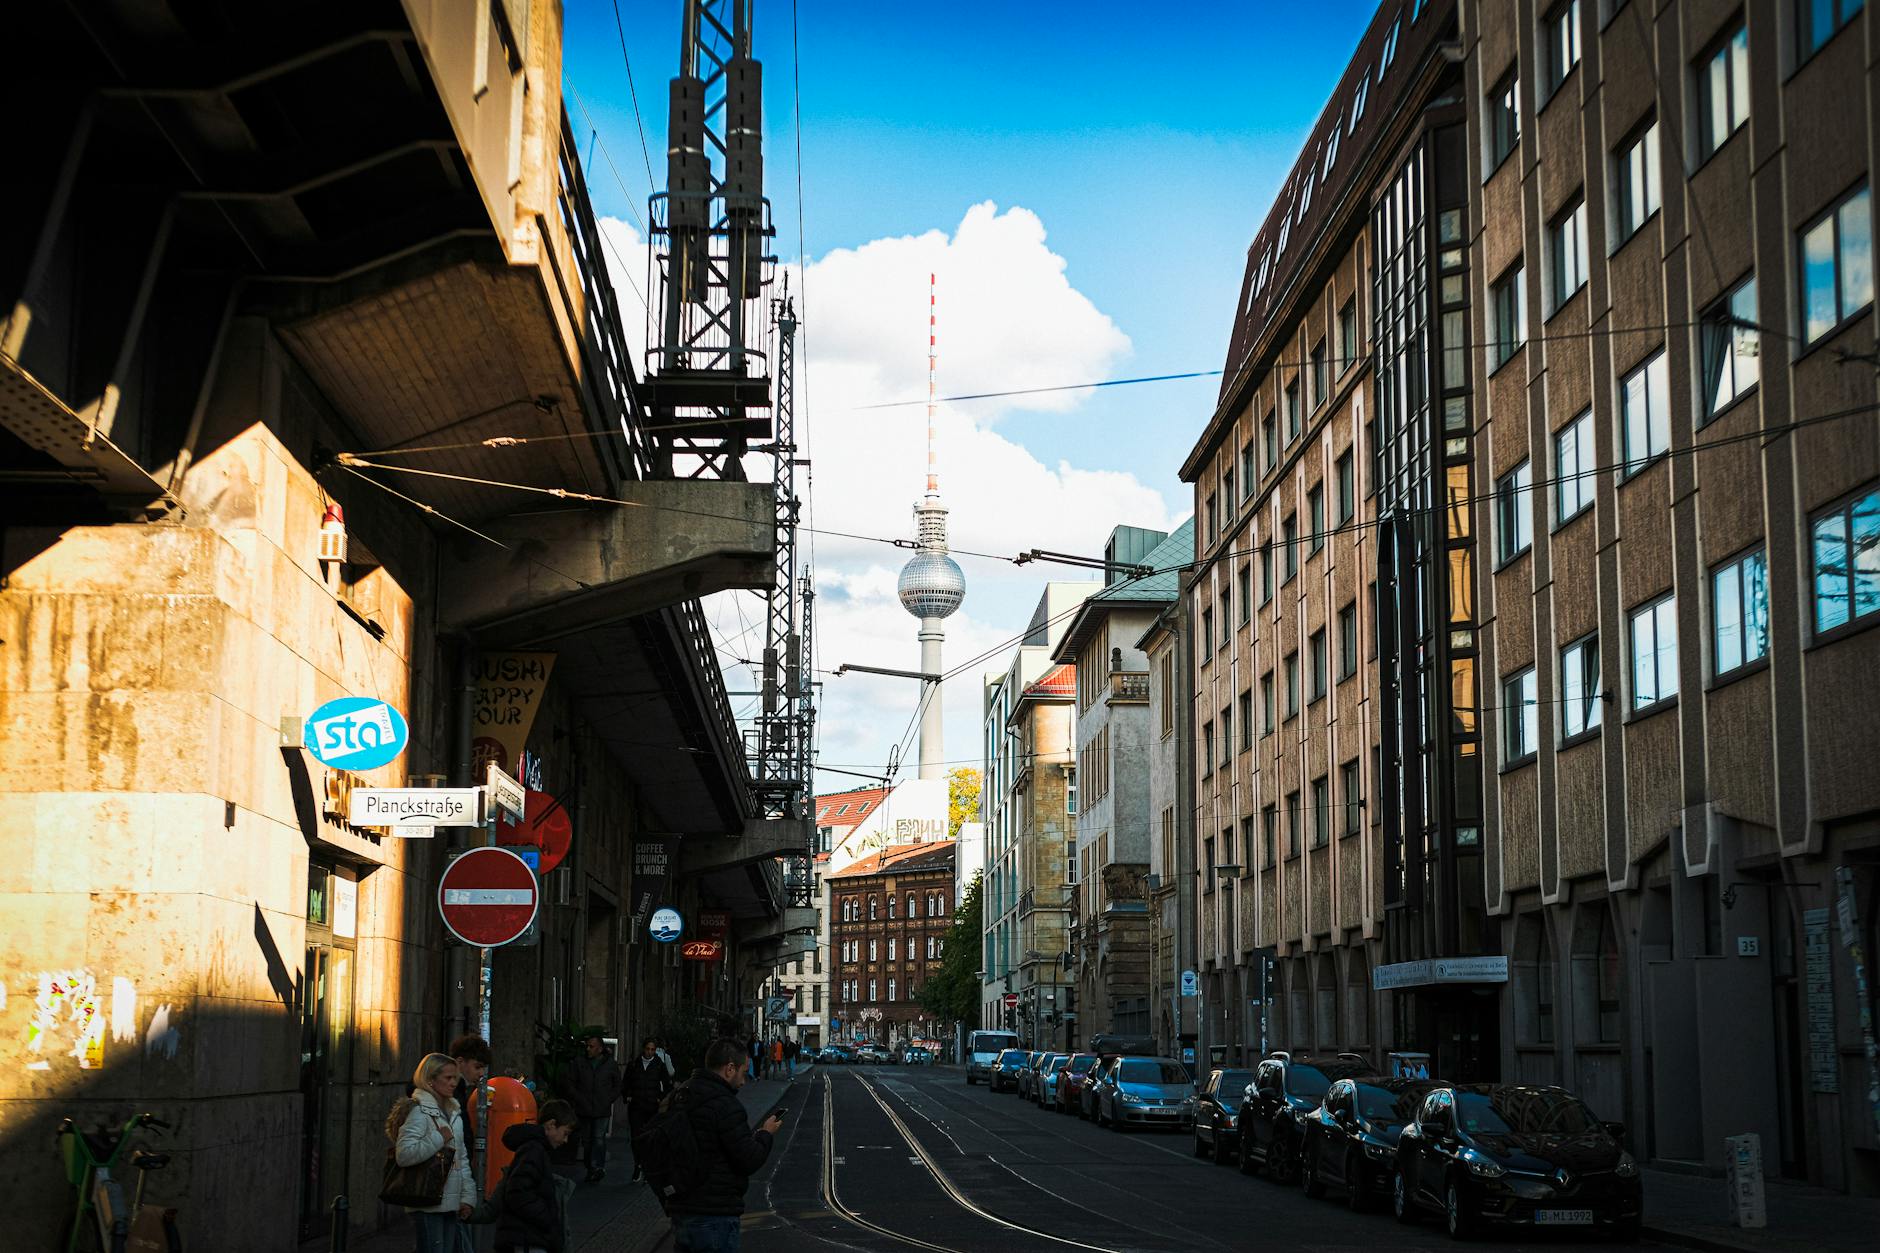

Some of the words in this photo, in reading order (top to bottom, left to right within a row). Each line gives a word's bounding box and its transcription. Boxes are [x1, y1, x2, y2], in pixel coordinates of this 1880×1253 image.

[474, 687, 534, 704] APPY
[473, 706, 521, 725] OUR
[324, 716, 381, 750] sta
[367, 796, 463, 818] Planckstraße
[635, 843, 664, 854] COFFEE
[635, 854, 668, 865] BRUNCH
[643, 865, 665, 876] MORE
[1742, 941, 1755, 952] 35
[1569, 1211, 1591, 1221] 1992
